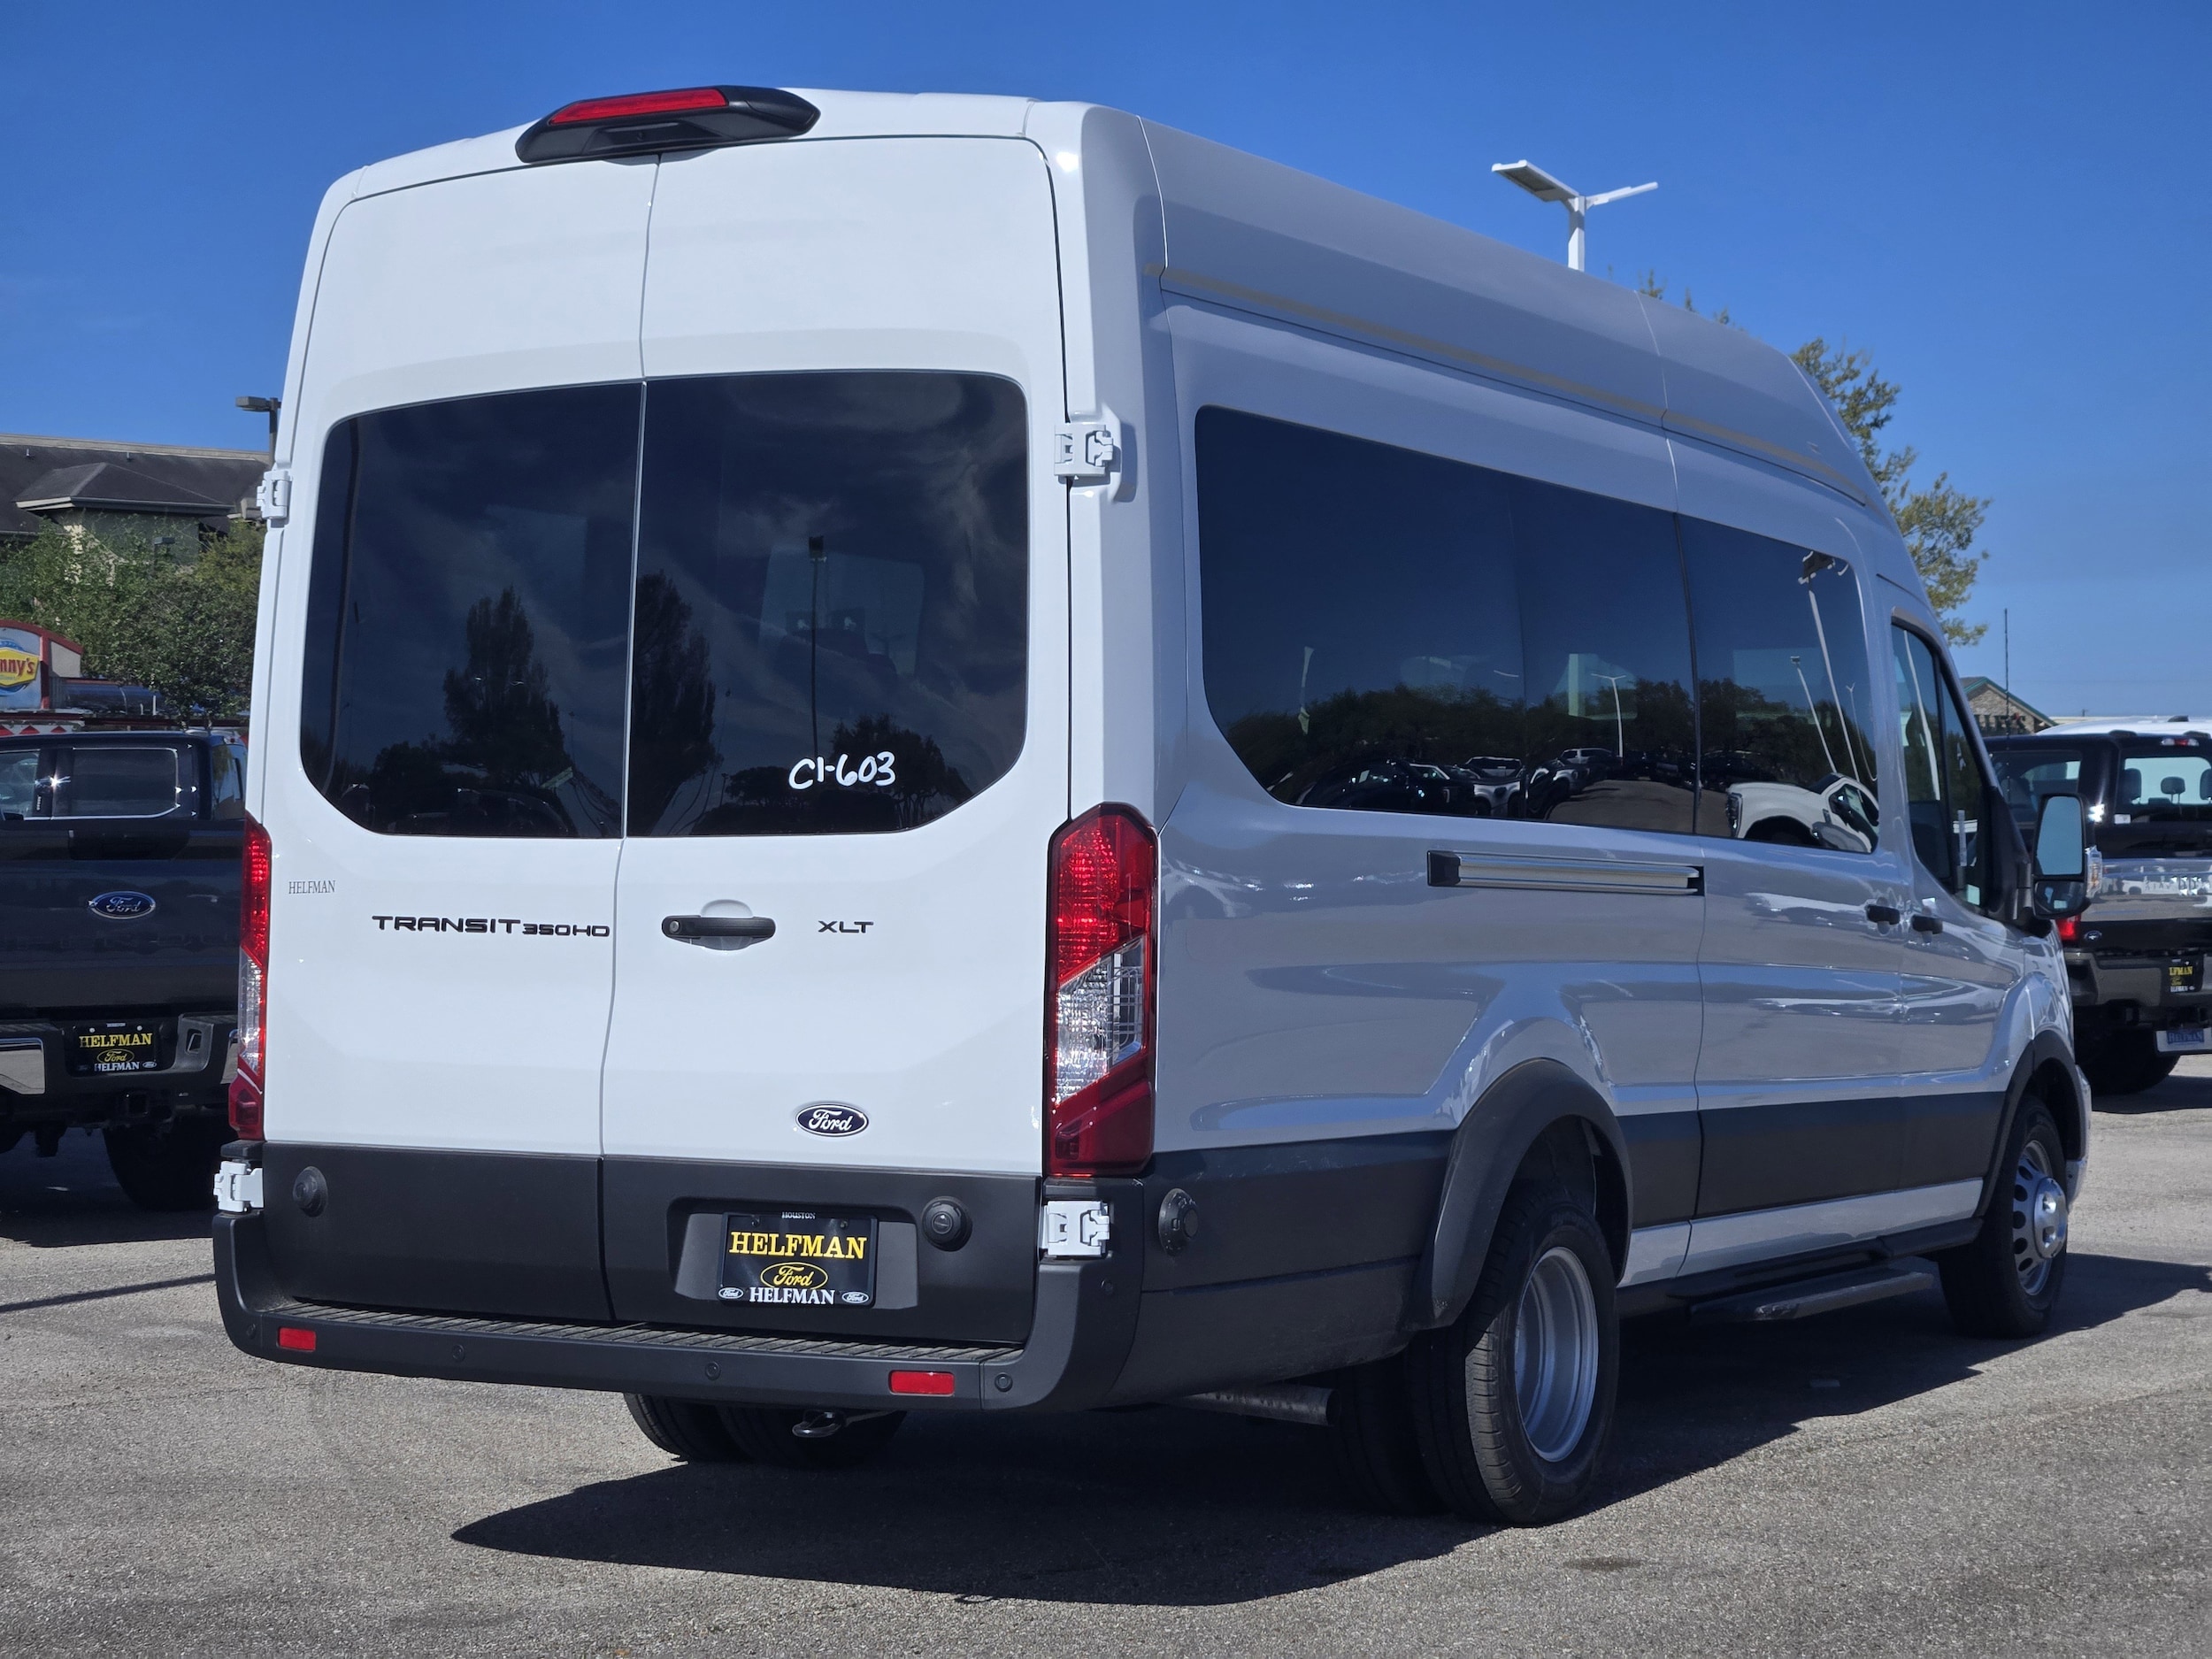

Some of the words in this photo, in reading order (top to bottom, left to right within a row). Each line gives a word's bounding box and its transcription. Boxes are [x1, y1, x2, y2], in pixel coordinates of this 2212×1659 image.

[288, 879, 336, 895] HELFMAN
[106, 896, 142, 912] Ford
[818, 920, 874, 933] XLT
[79, 1033, 153, 1048] HELFMAN
[104, 1049, 127, 1062] Ford
[94, 1062, 140, 1071] HELFMAN
[808, 1109, 853, 1131] Ford
[729, 1231, 867, 1259] HELFMAN
[773, 1265, 815, 1286] Ford
[749, 1286, 835, 1305] HELFMAN
